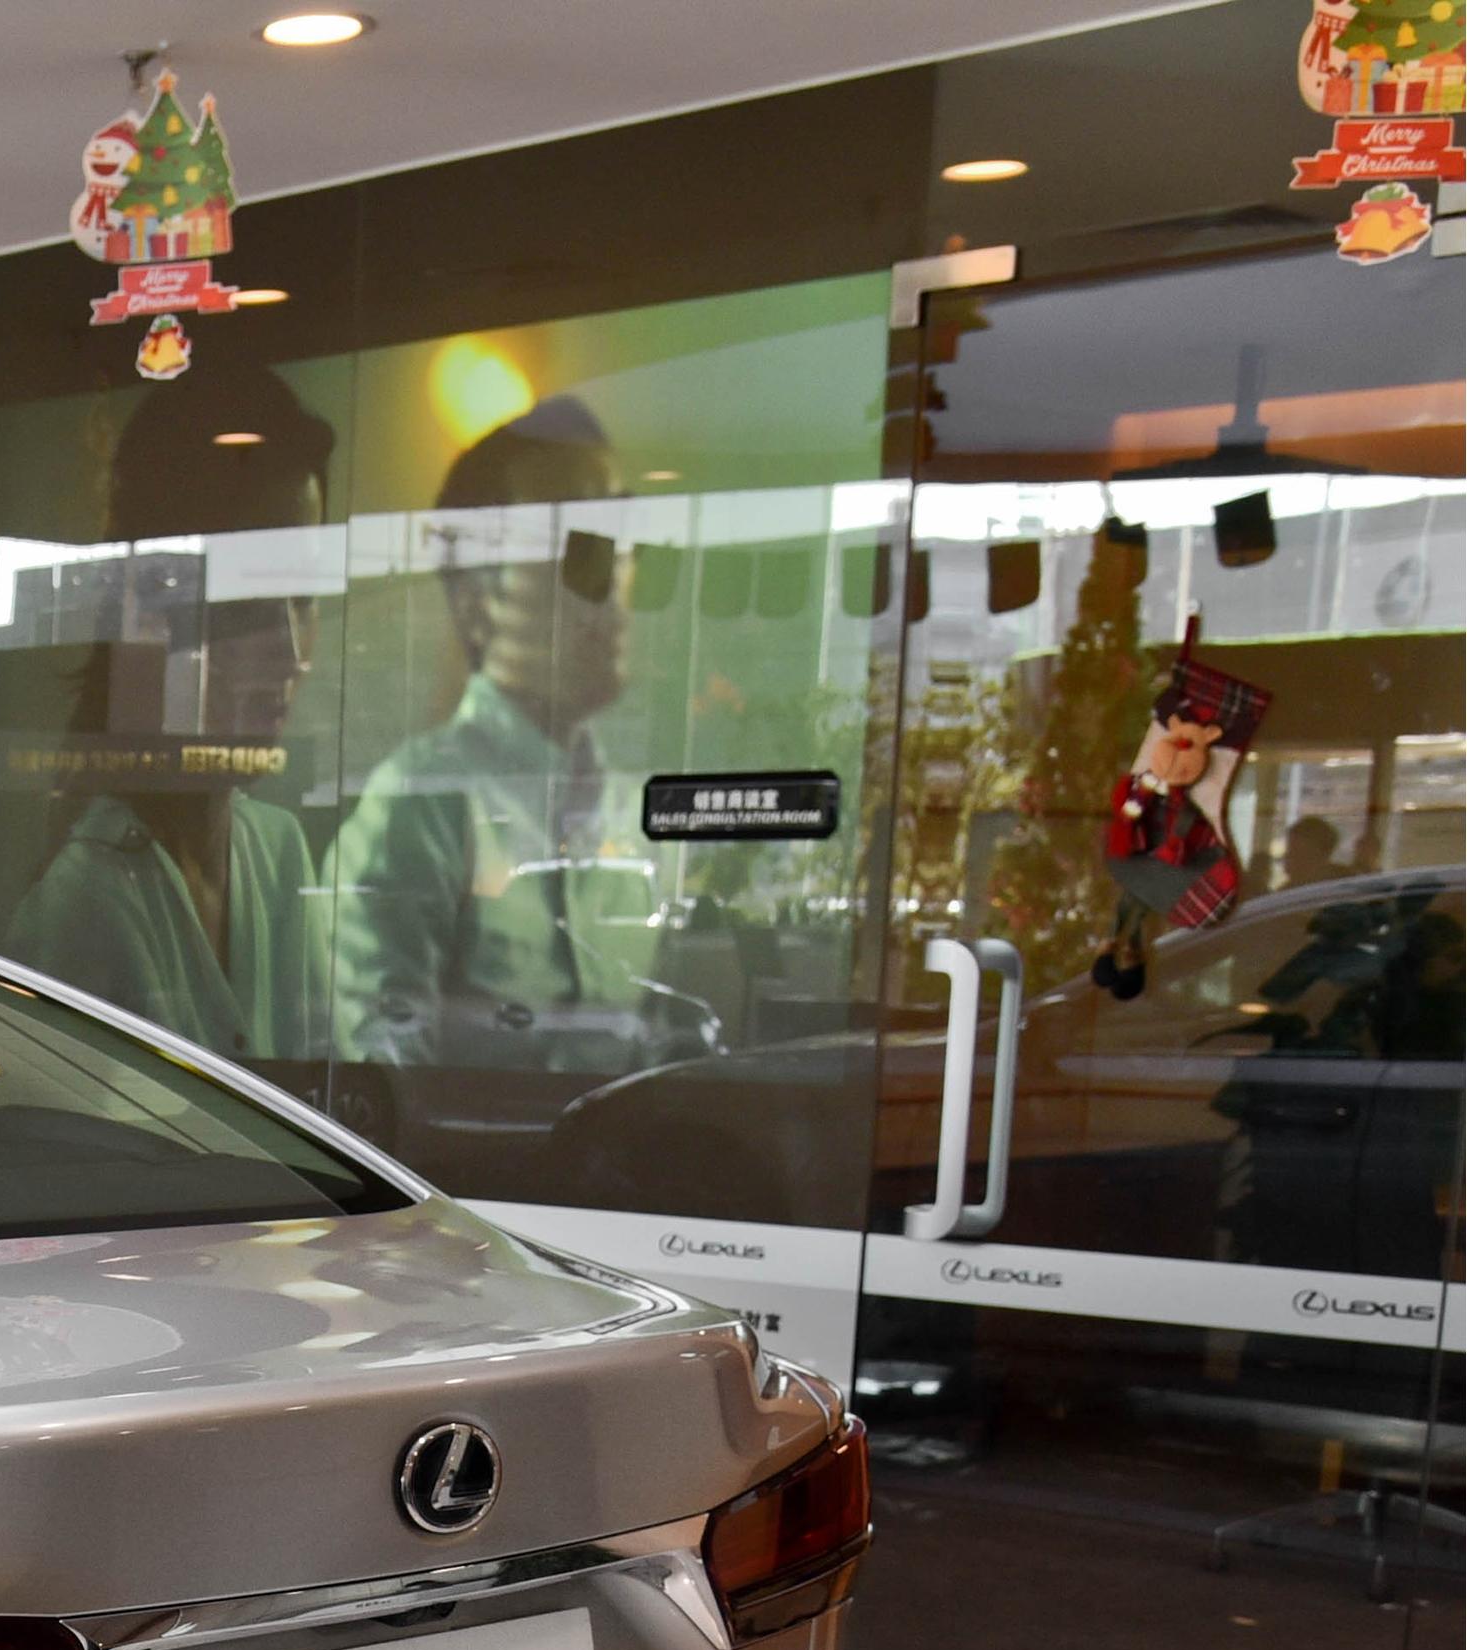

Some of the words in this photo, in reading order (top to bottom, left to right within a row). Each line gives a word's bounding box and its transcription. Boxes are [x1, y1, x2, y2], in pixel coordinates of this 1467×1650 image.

[1360, 122, 1425, 145] Merry
[1341, 153, 1438, 177] Christmas
[687, 1240, 765, 1261] LEXUS
[974, 1265, 1063, 1289] LEXUS
[1331, 1298, 1435, 1322] LEXUS
